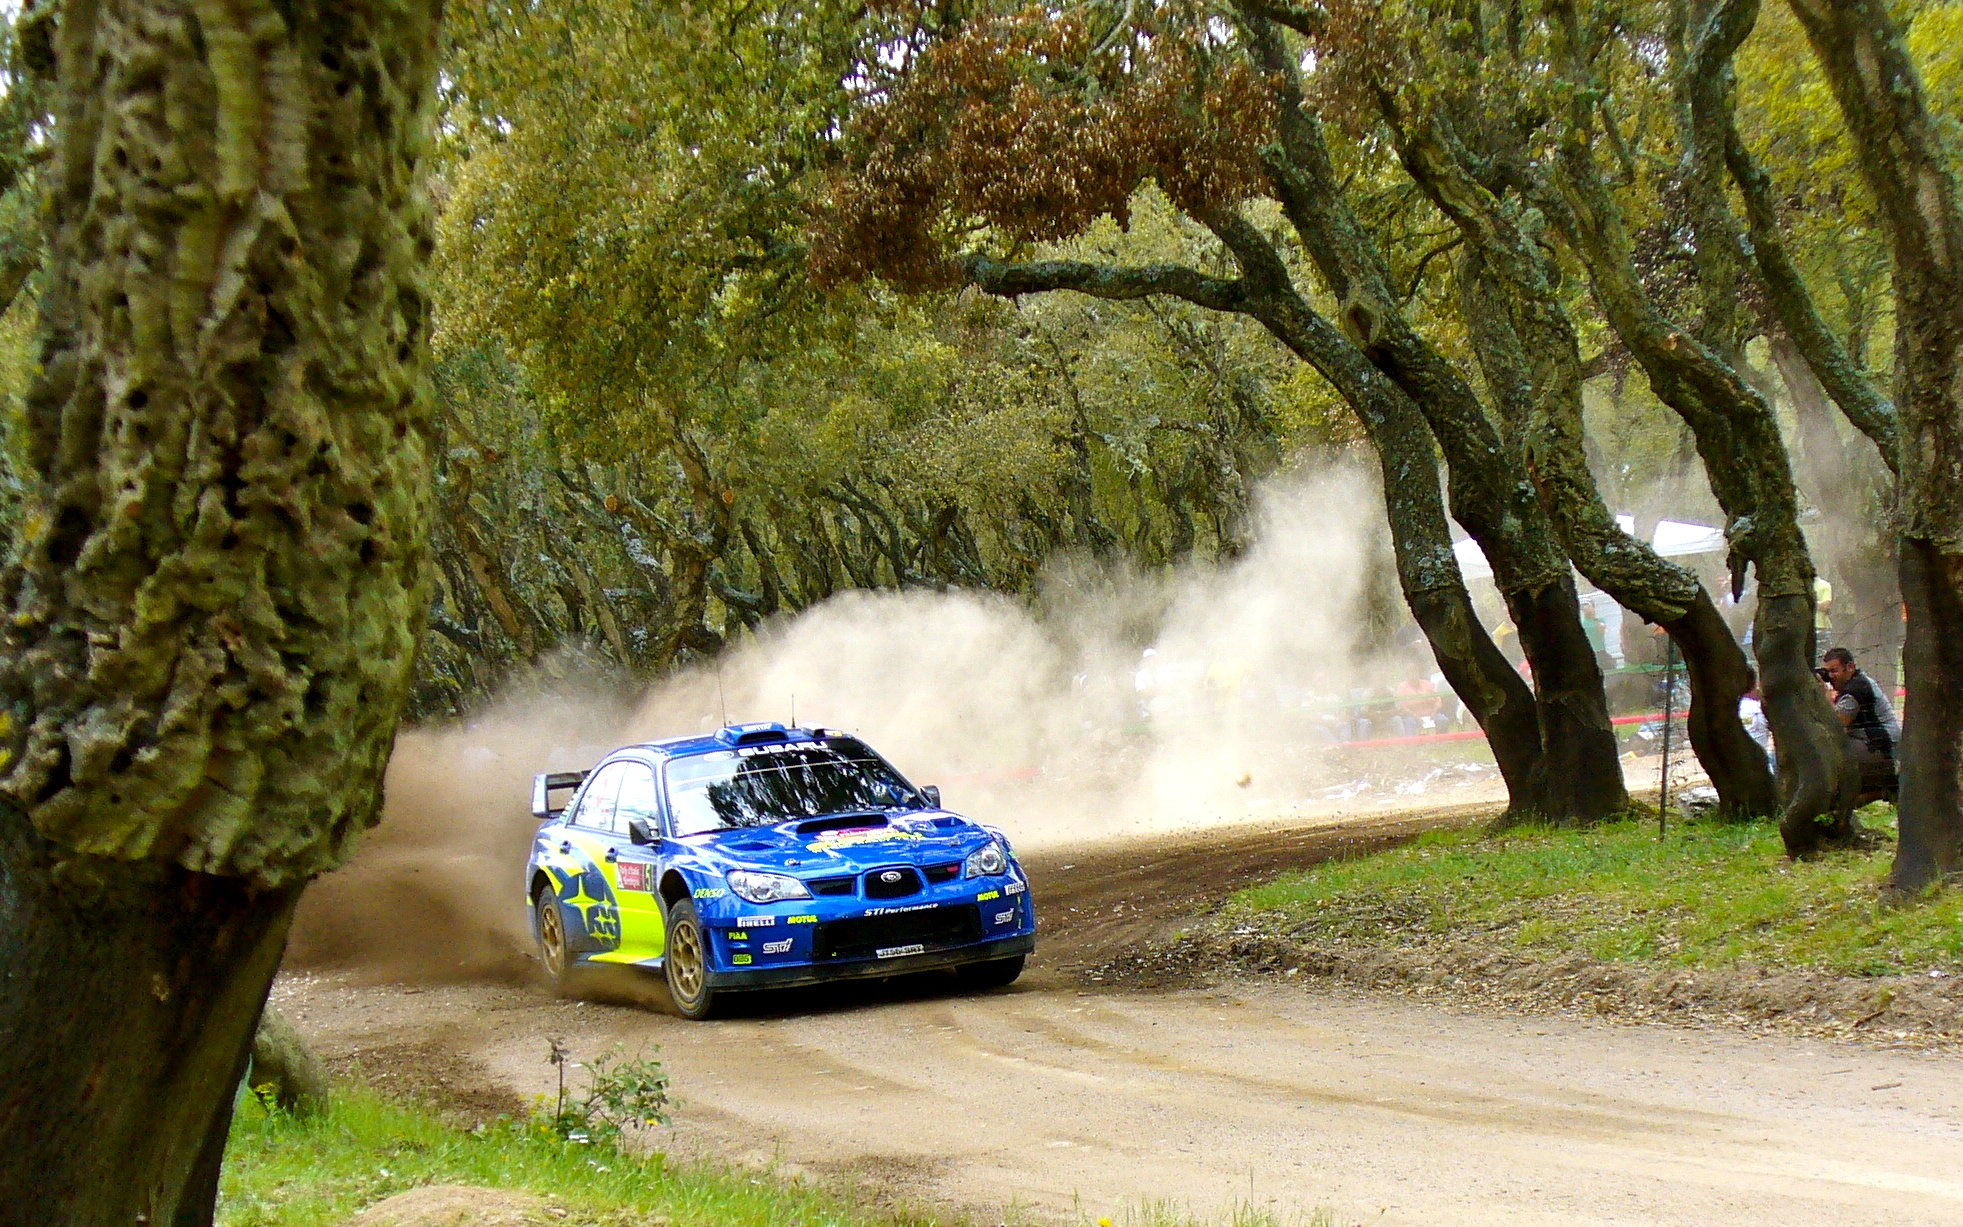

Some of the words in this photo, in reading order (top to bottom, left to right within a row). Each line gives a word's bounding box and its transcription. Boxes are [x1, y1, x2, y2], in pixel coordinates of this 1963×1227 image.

[738, 741, 828, 757] SUBARU
[645, 863, 652, 891] 5
[694, 888, 725, 898] DENSO
[864, 908, 884, 917] STI
[885, 903, 939, 914] Performance
[737, 916, 775, 928] PIRELLI
[787, 915, 818, 924] MOTUL
